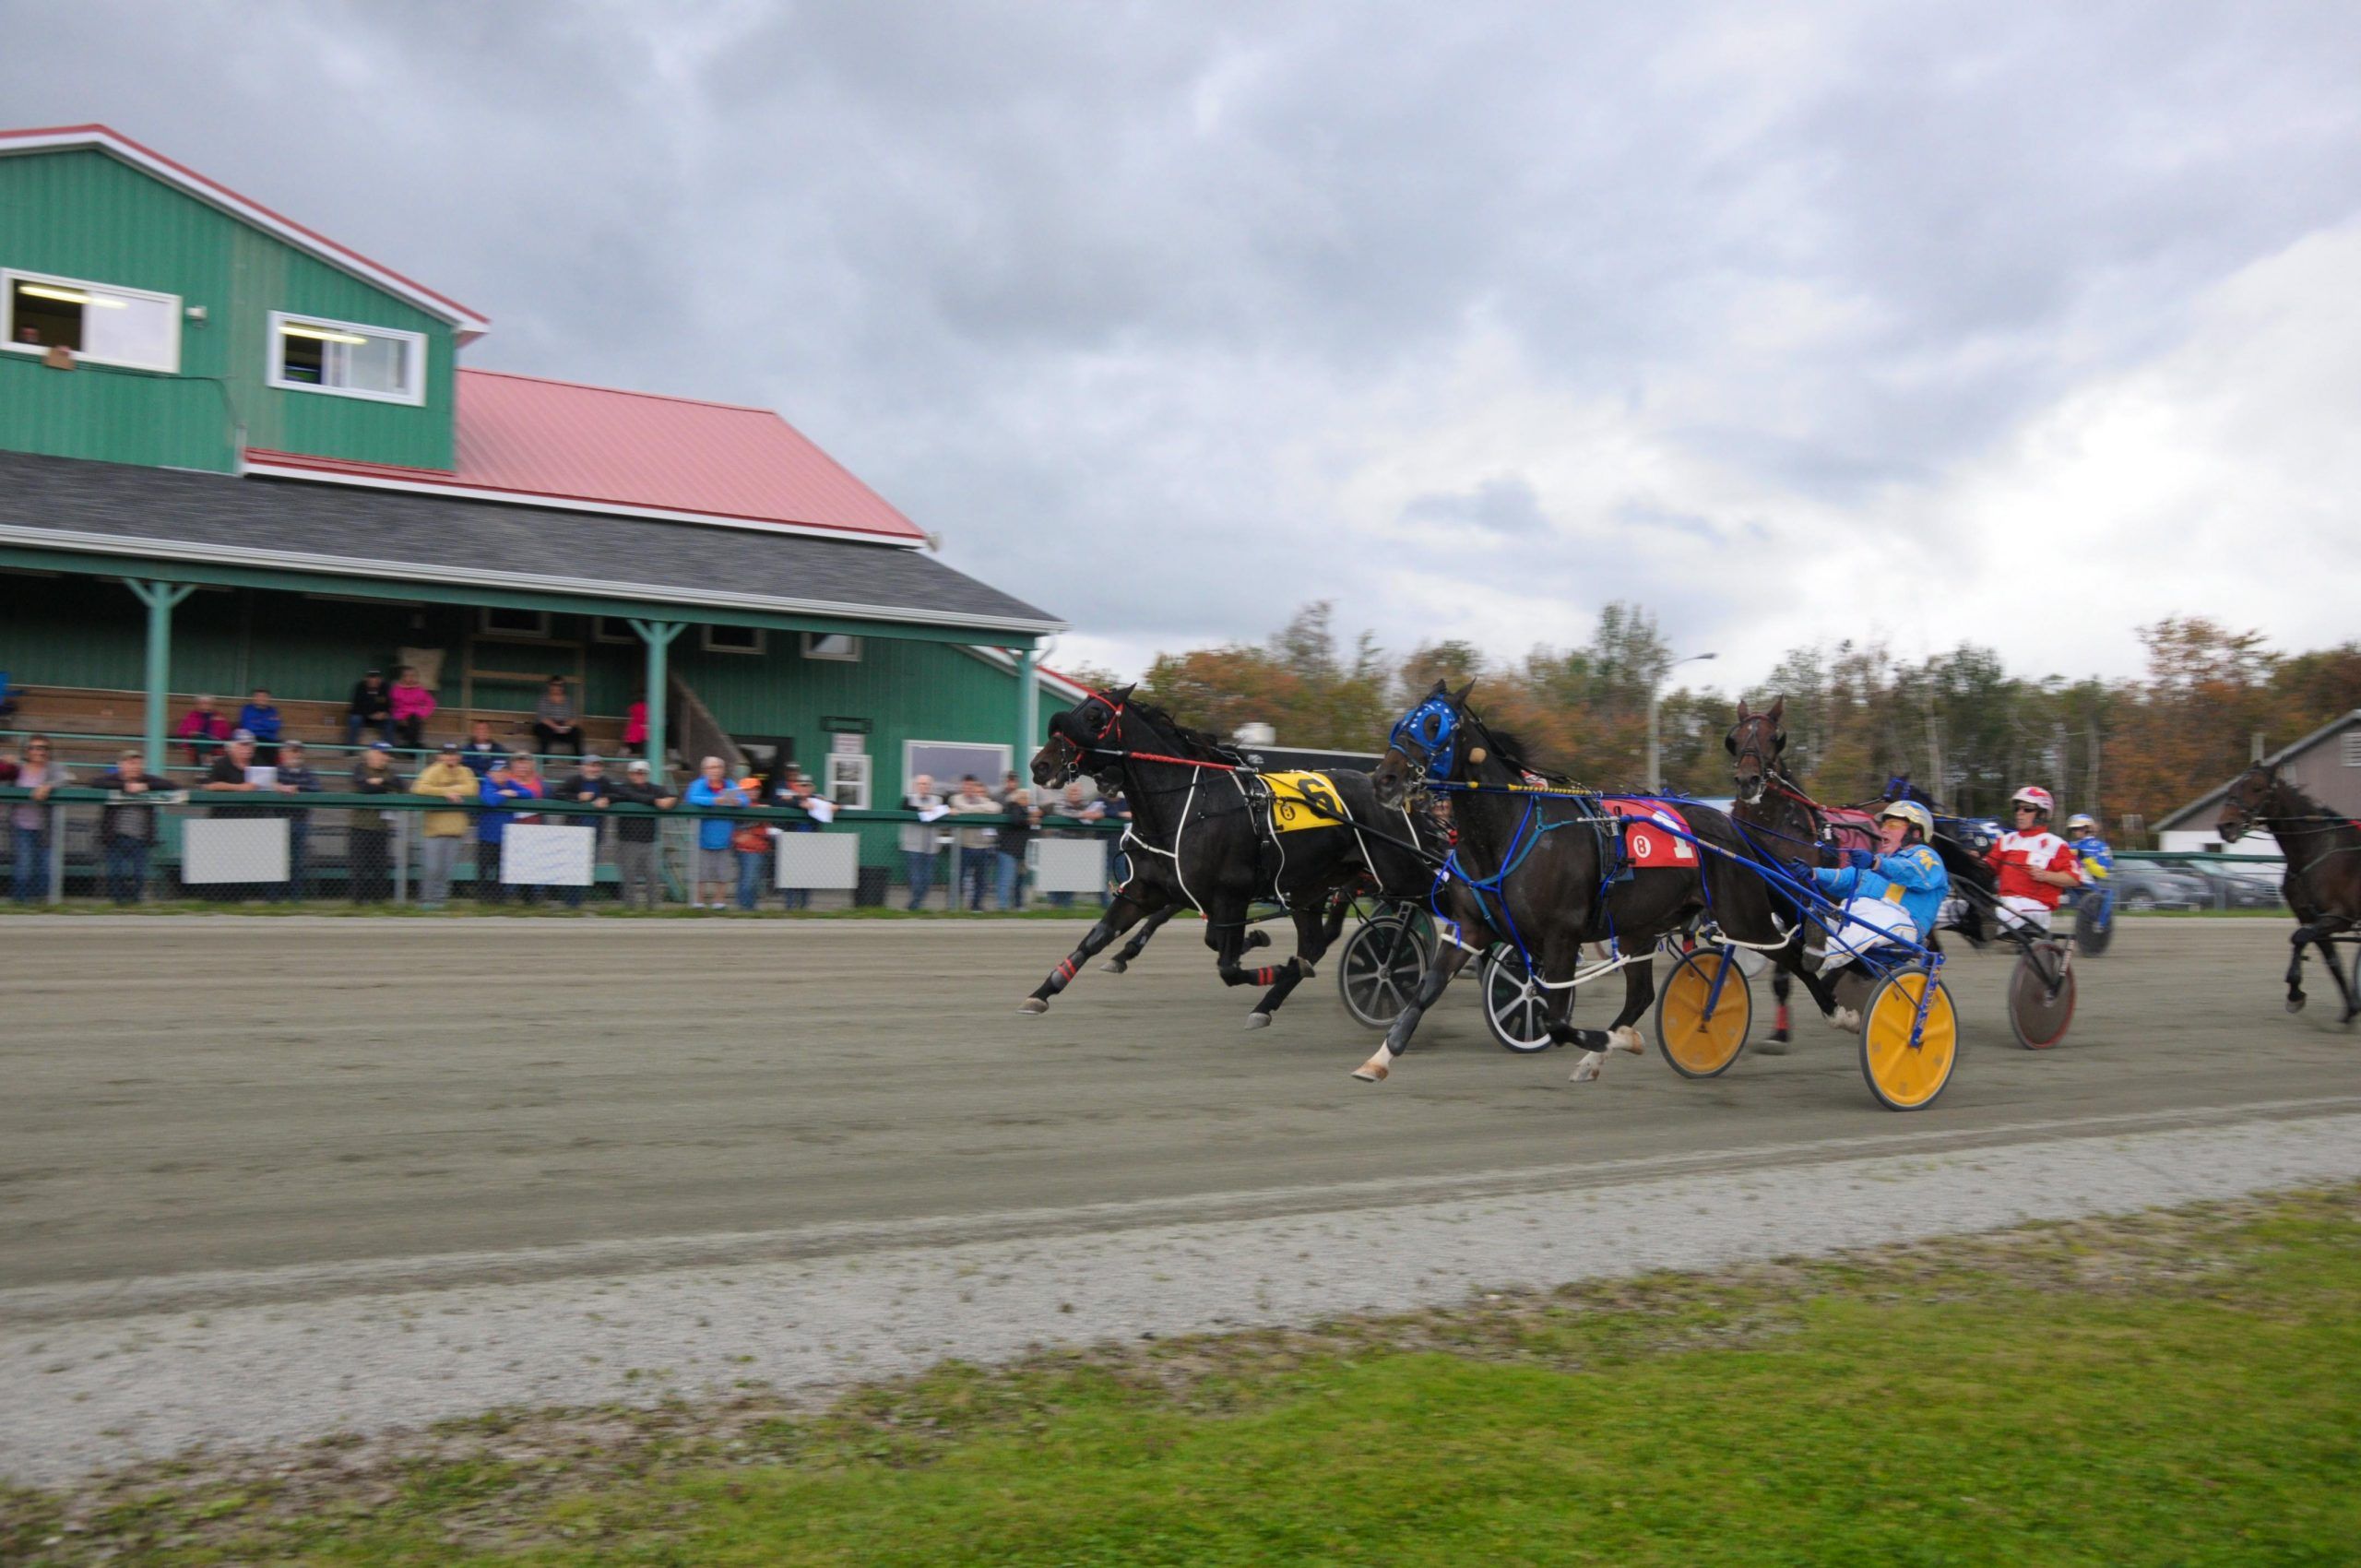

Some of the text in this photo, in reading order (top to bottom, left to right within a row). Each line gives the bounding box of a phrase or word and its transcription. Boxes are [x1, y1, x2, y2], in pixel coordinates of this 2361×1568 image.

[1298, 778, 1337, 819] 6
[1636, 837, 1647, 855] 8
[1652, 810, 1693, 859] 1
